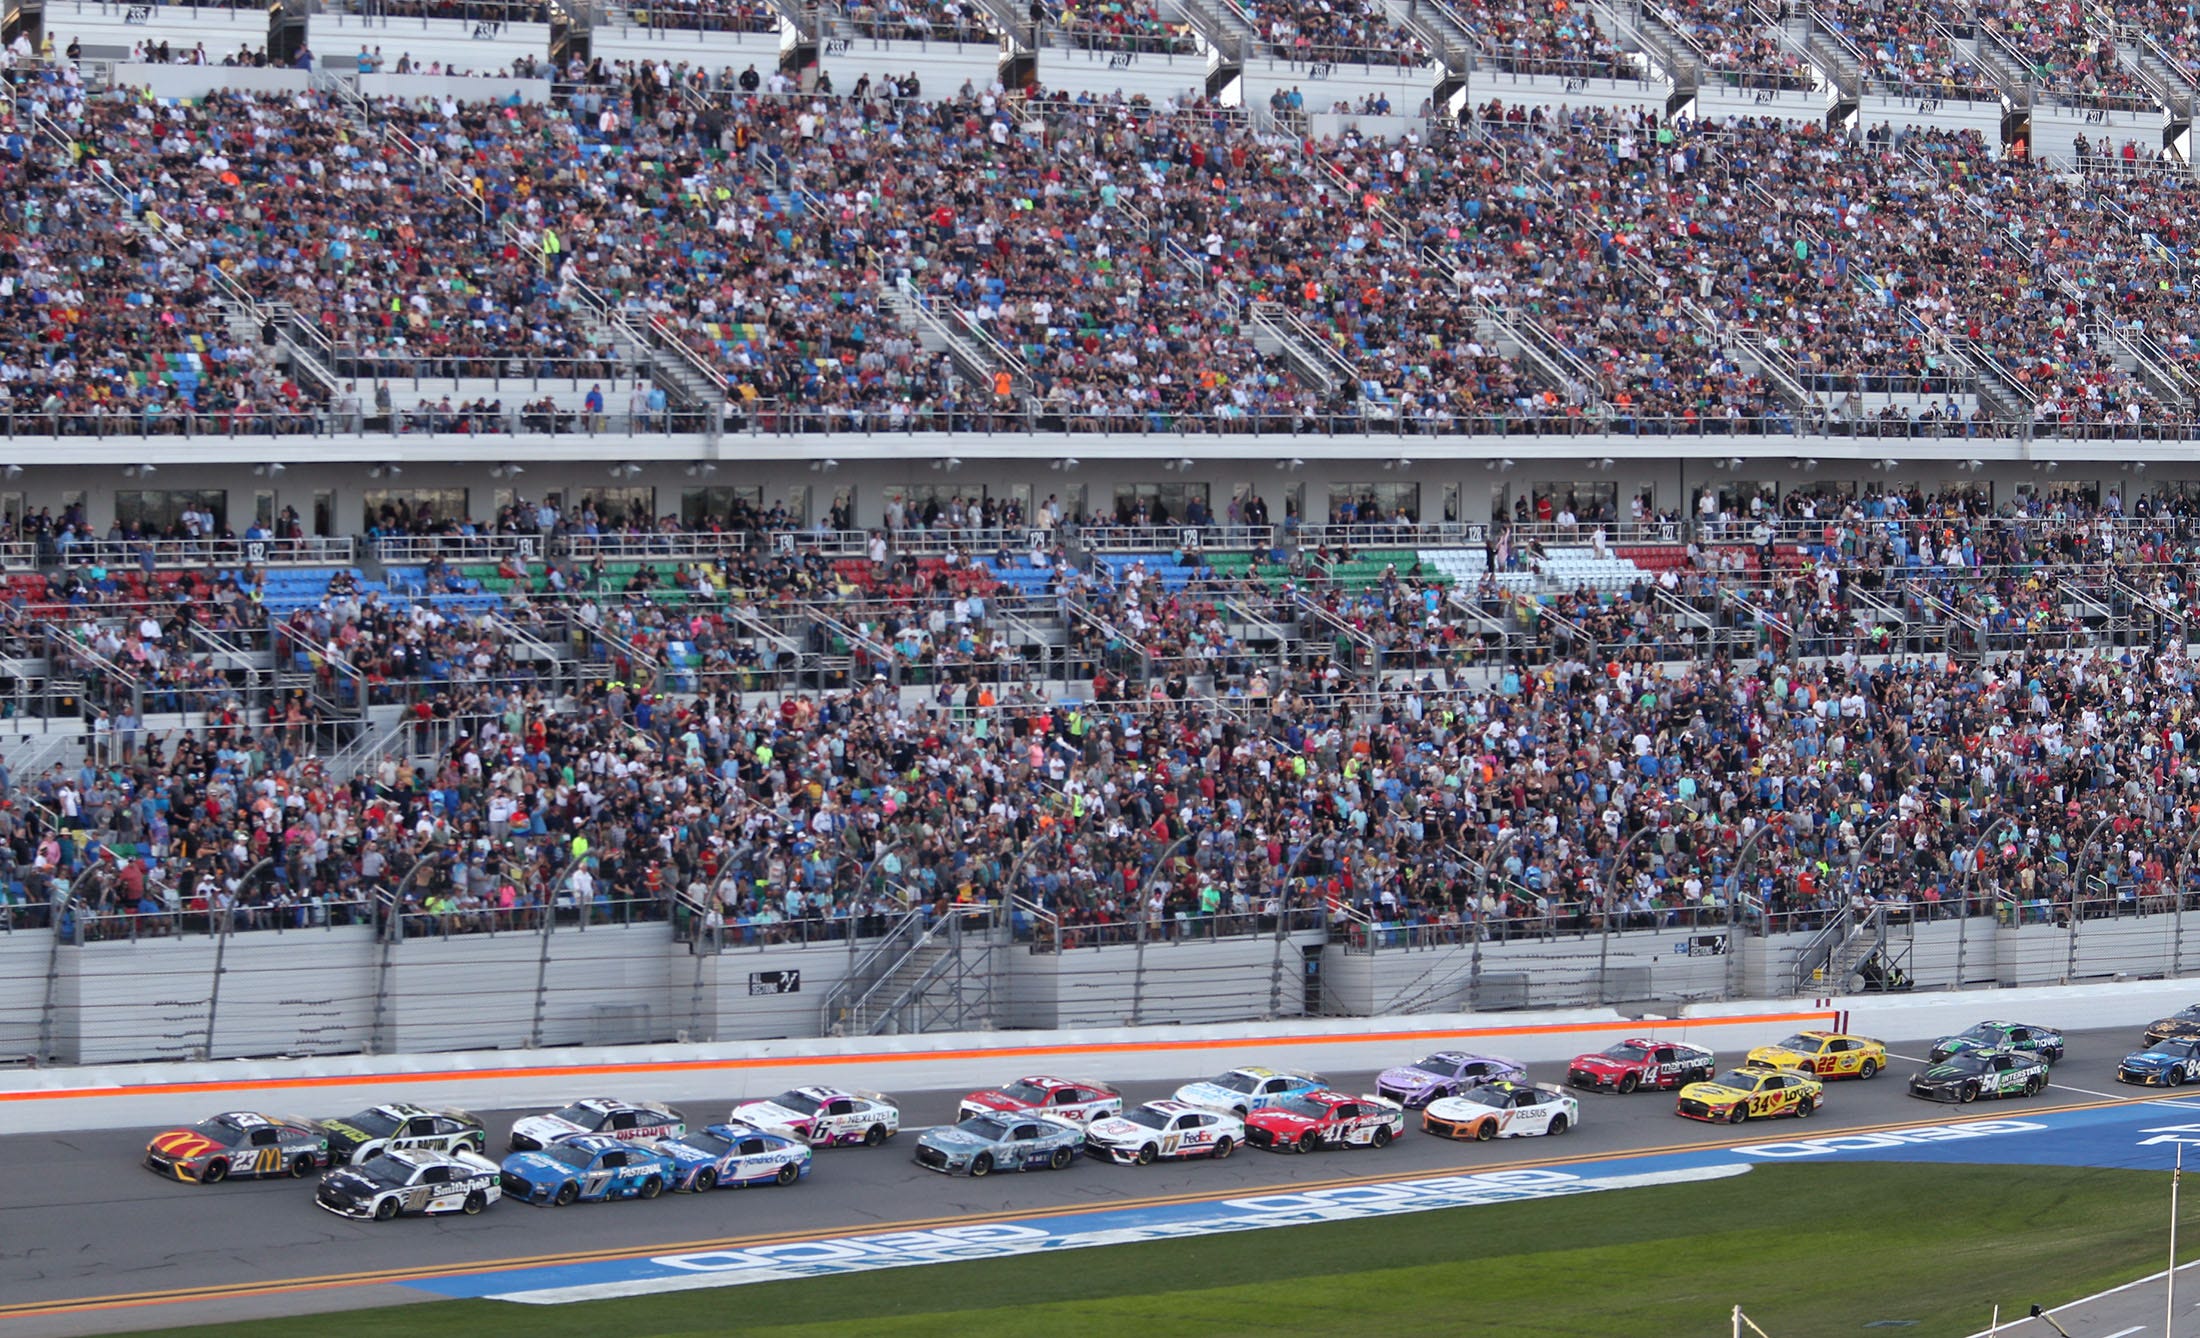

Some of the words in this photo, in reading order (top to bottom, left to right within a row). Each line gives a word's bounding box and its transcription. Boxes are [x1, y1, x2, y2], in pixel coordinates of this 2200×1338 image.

[828, 40, 846, 56] 333
[1111, 54, 1129, 69] 332
[1313, 64, 1327, 80] 331
[1759, 90, 1772, 105] 329
[1922, 101, 1936, 115] 328
[2088, 111, 2101, 125] 327
[1030, 532, 1044, 548] 129
[1184, 530, 1198, 546] 129
[1469, 526, 1482, 542] 128
[1662, 526, 1674, 540] 127
[248, 542, 265, 561] 132
[519, 539, 534, 556] 131
[780, 535, 794, 552] 130
[1661, 1058, 1709, 1073] mahindra
[1817, 1056, 1837, 1072] 22
[1640, 1067, 1659, 1084] 14
[1981, 1074, 2000, 1091] 54
[2001, 1066, 2041, 1083] INTERSTATE
[1751, 1096, 1769, 1113] 34
[1501, 1111, 1515, 1130] 7
[1516, 1109, 1548, 1124] CELSIUS
[812, 1120, 833, 1141] 6
[1323, 1123, 1346, 1143] 41
[1731, 1120, 2046, 1157] GEICO
[1161, 1135, 1181, 1153] 11
[1184, 1131, 1213, 1145] FedEx
[232, 1149, 259, 1170] 23
[998, 1146, 1015, 1164] 4
[721, 1160, 741, 1179] 5
[433, 1176, 490, 1197] Smithfield
[579, 1172, 615, 1196] 17
[1221, 1170, 1580, 1212] GEICO
[659, 1223, 1050, 1271] GEICO
